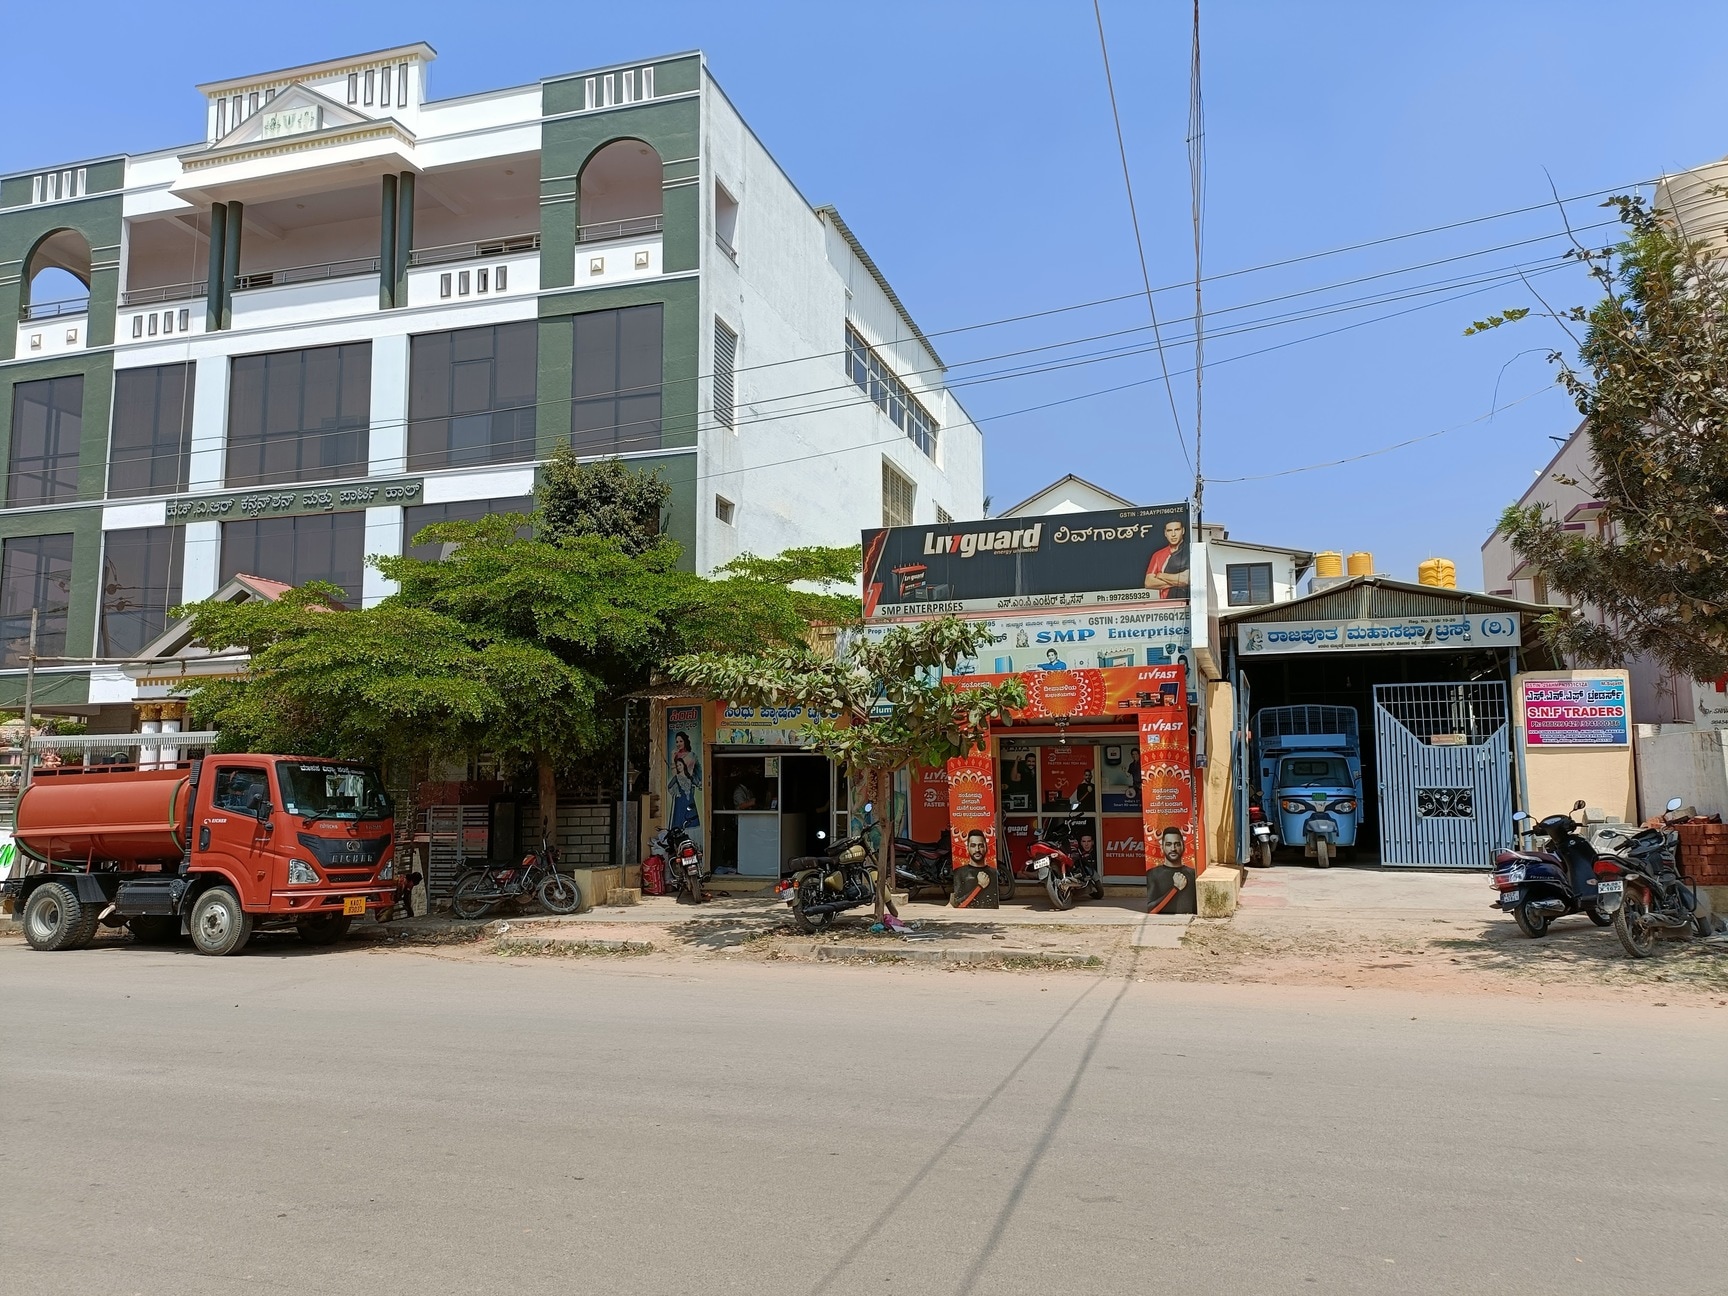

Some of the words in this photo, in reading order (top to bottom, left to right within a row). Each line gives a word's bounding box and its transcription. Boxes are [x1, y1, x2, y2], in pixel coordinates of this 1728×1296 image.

[303, 490, 333, 510] ಮತ್ತು
[385, 481, 422, 499] ಹಾಲ್
[881, 604, 901, 616] SMP
[903, 601, 964, 615] ENTERPRISES
[1088, 616, 1113, 626] GSTIN
[1035, 628, 1096, 644] SMP
[1107, 625, 1190, 641] Enterprises
[1267, 626, 1338, 644] ರಾಜಪೂತ
[1347, 624, 1426, 641] ಮಹಾಸಭಾ
[1481, 617, 1515, 638] (ರಿ.)
[1138, 668, 1178, 680] LIVFAST
[1528, 707, 1561, 717] S.N.F
[1564, 706, 1624, 717] TRADERS
[1141, 718, 1183, 732] LIVFAST
[924, 769, 949, 780] LIVFA
[1007, 825, 1029, 833] guard
[1106, 836, 1145, 851] LIVFA
[331, 854, 373, 863] EICHER
